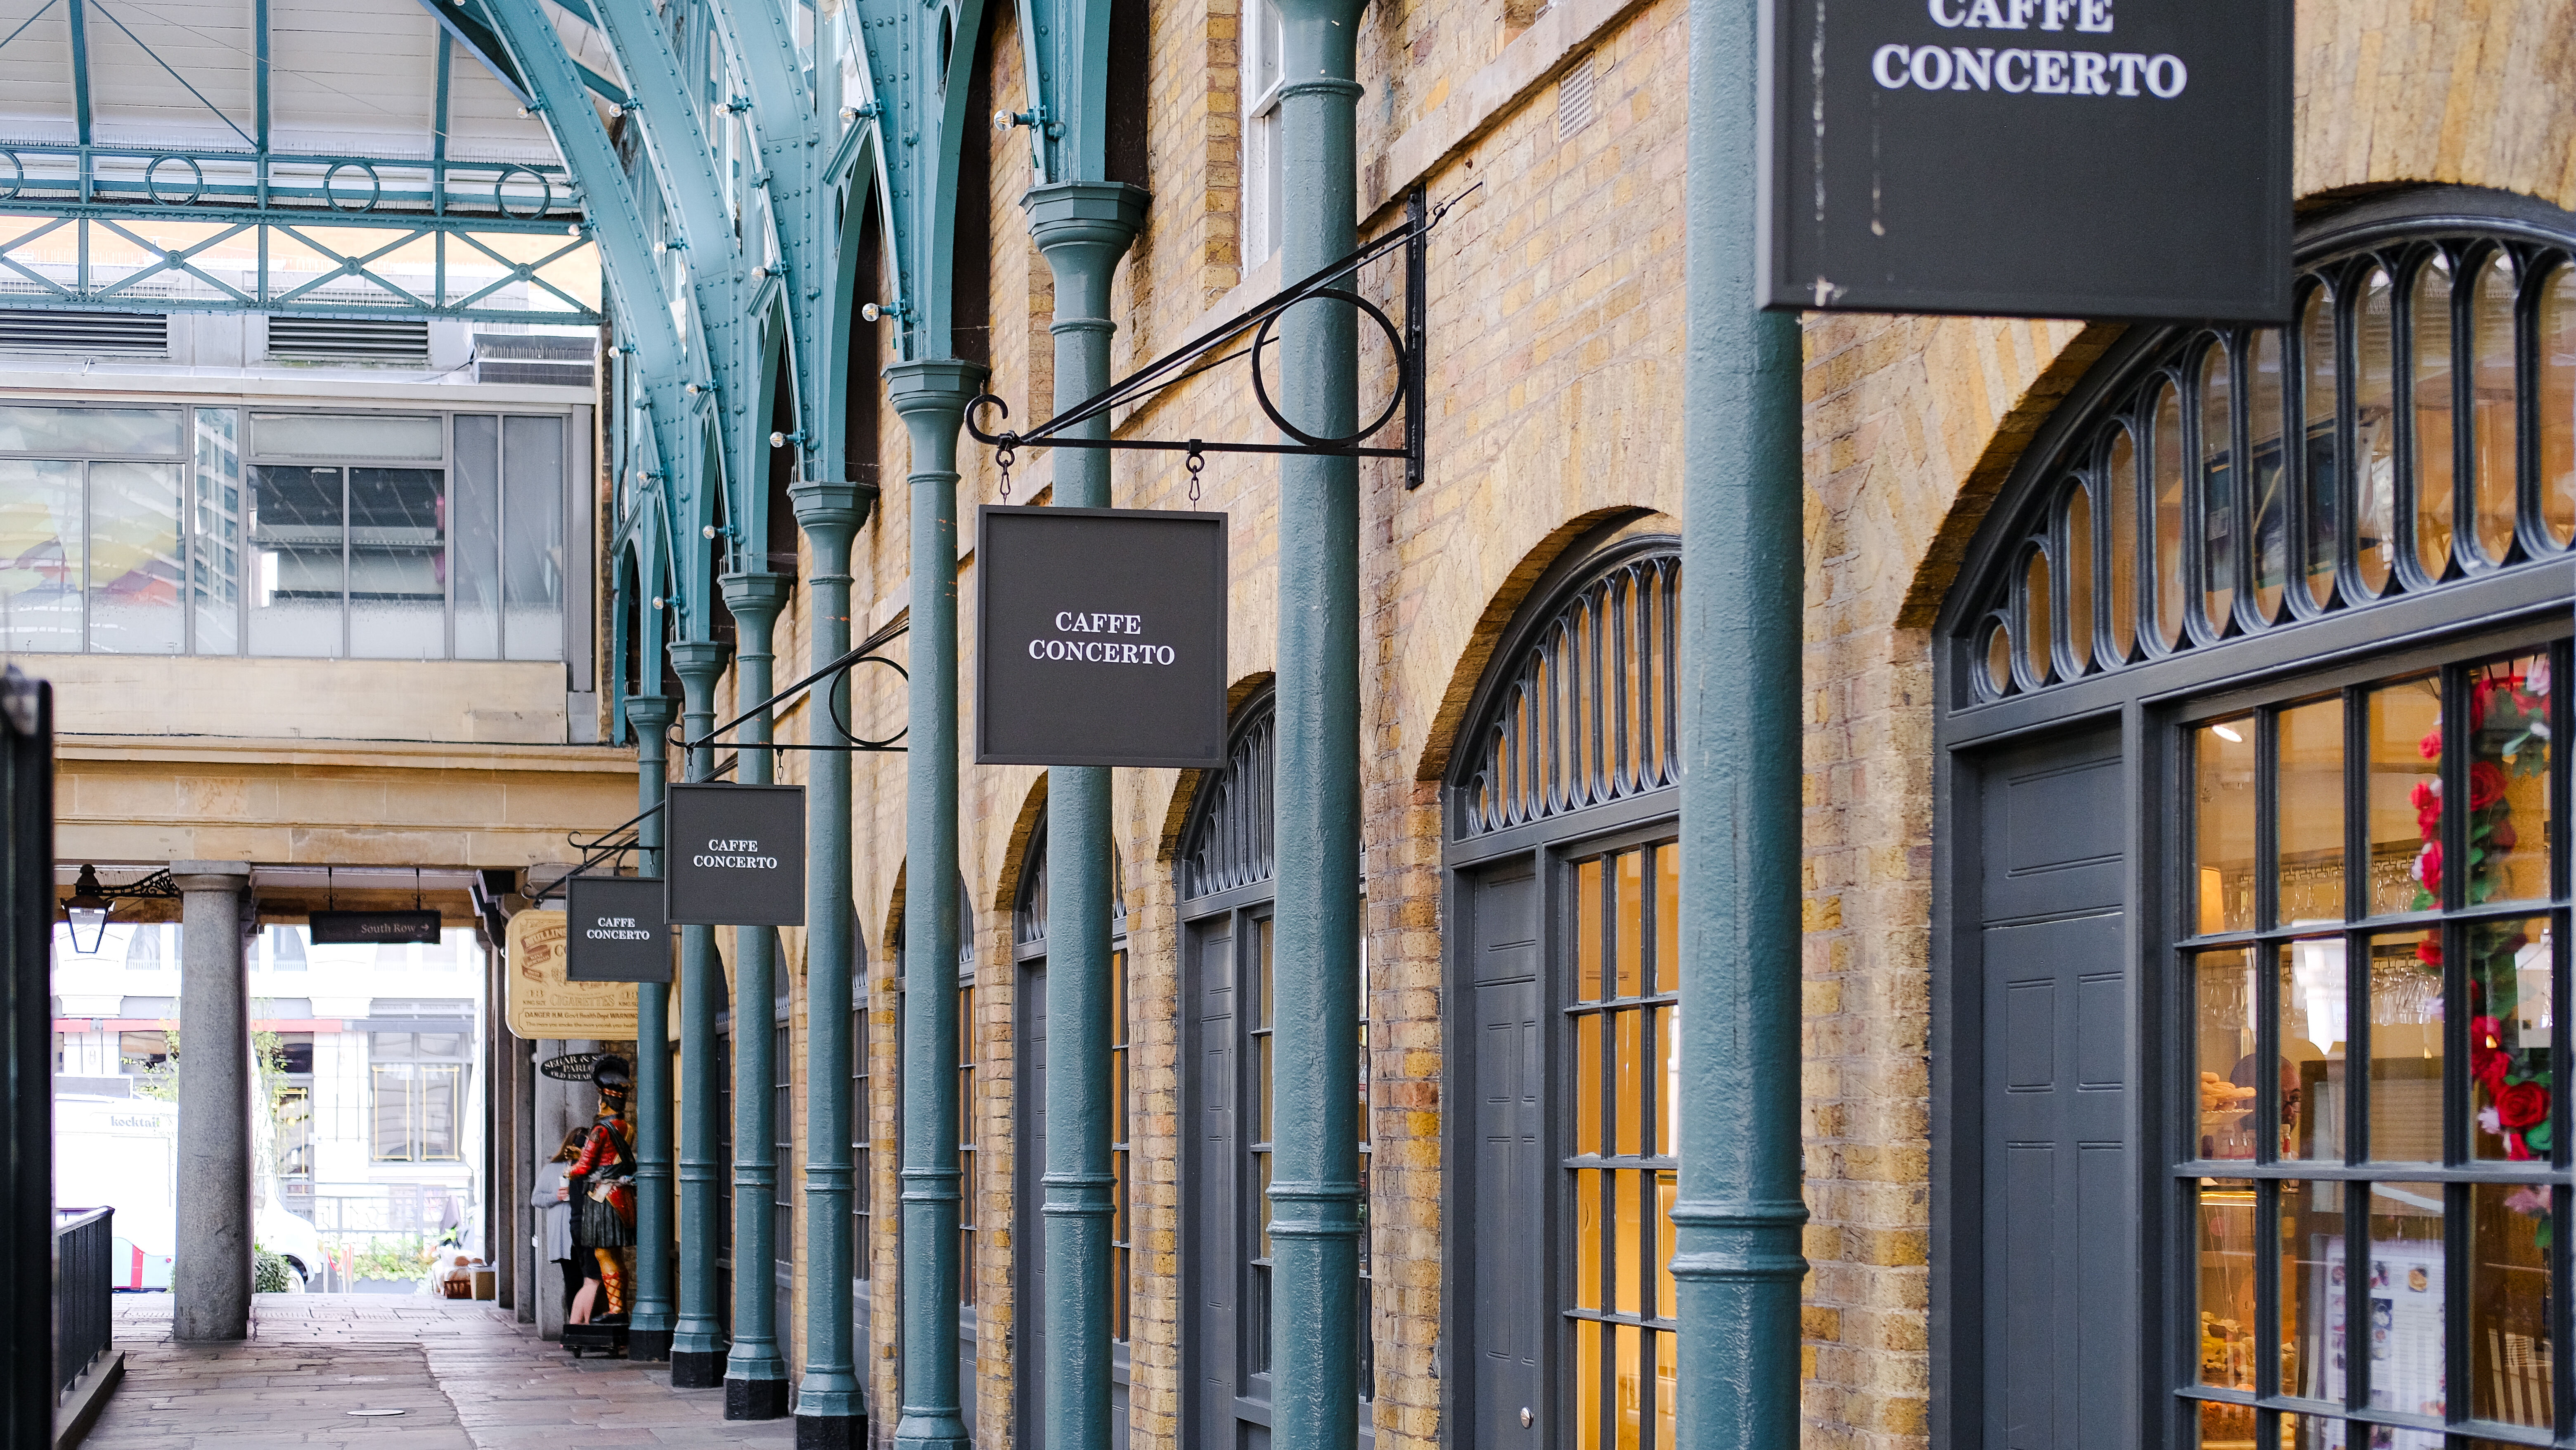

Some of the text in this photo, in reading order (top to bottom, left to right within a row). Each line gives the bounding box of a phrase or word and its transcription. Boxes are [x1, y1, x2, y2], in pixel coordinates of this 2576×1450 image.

[1928, 0, 2114, 33] CAFFE
[1871, 43, 2188, 99] CONCERTO
[1055, 611, 1141, 635] CAFFE
[1028, 639, 1175, 666] CONCERTO
[708, 839, 758, 852] CAFFE
[693, 855, 778, 869] CONCERTO
[361, 923, 416, 933] South Row
[597, 917, 635, 928] CAFFE
[586, 929, 650, 940] CONCERTO
[550, 994, 615, 1007] CIGARETTES
[580, 1054, 590, 1063] &
[550, 1070, 566, 1079] OLD
